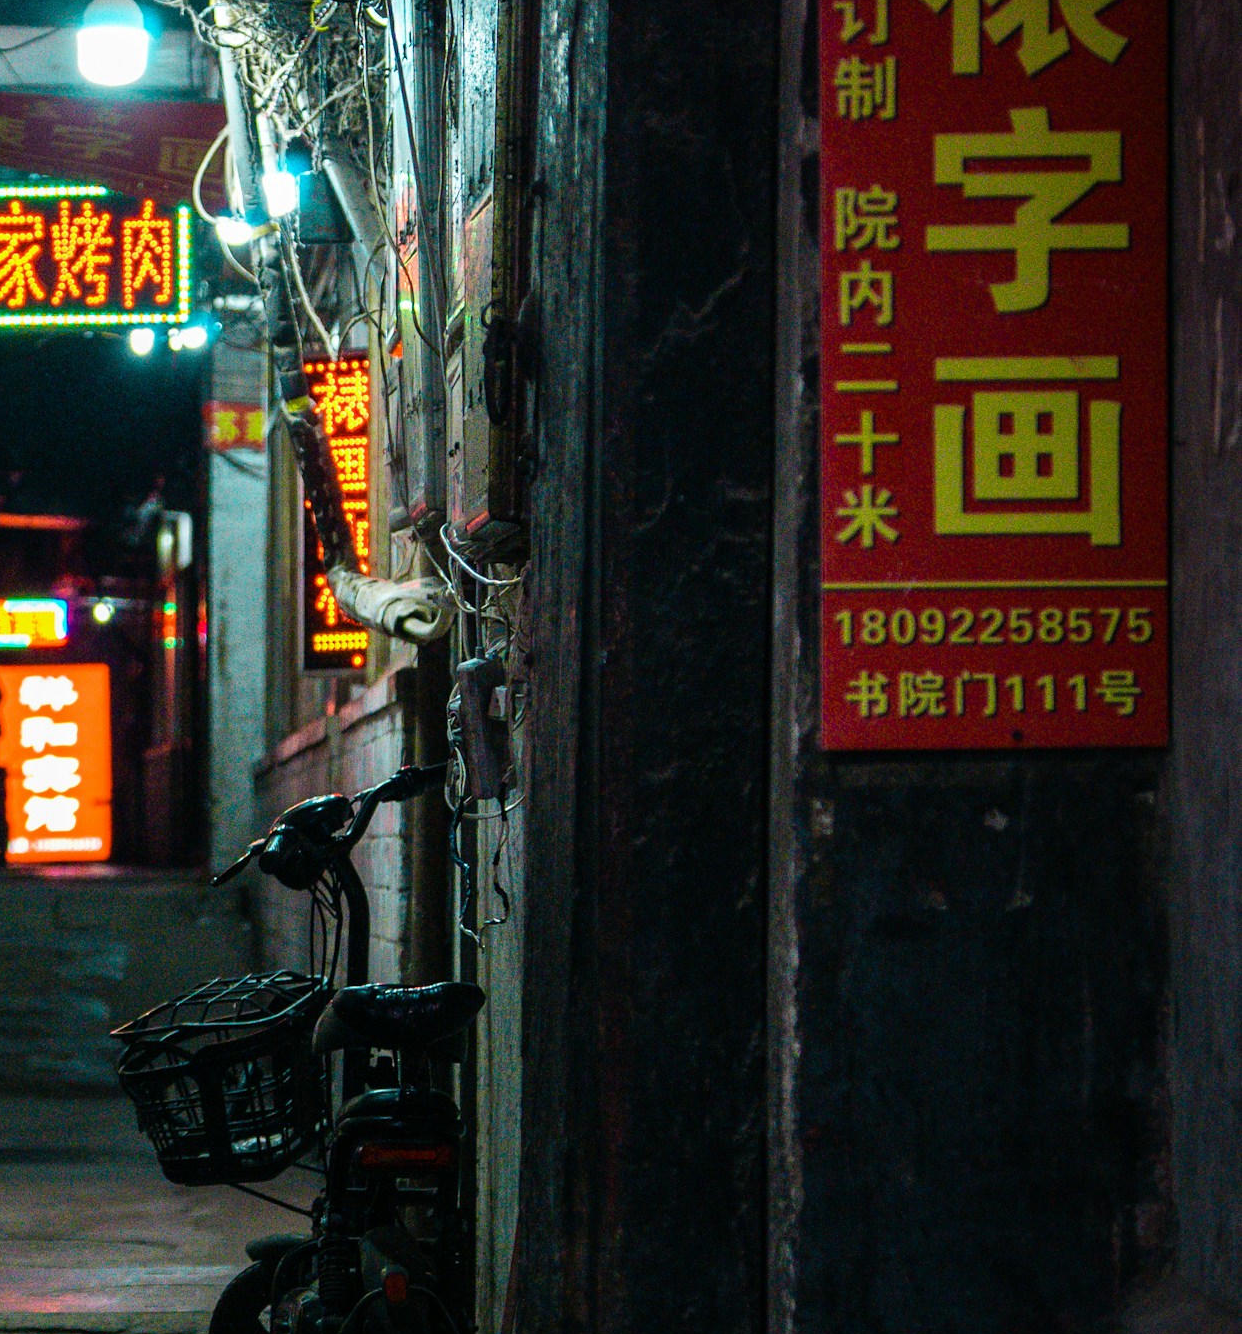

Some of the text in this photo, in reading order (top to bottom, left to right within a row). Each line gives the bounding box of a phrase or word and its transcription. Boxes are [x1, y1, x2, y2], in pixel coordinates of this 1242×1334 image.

[833, 184, 901, 549] 院内二十米
[834, 608, 1153, 646] 18092258575
[845, 669, 1142, 718] 书院门111号
